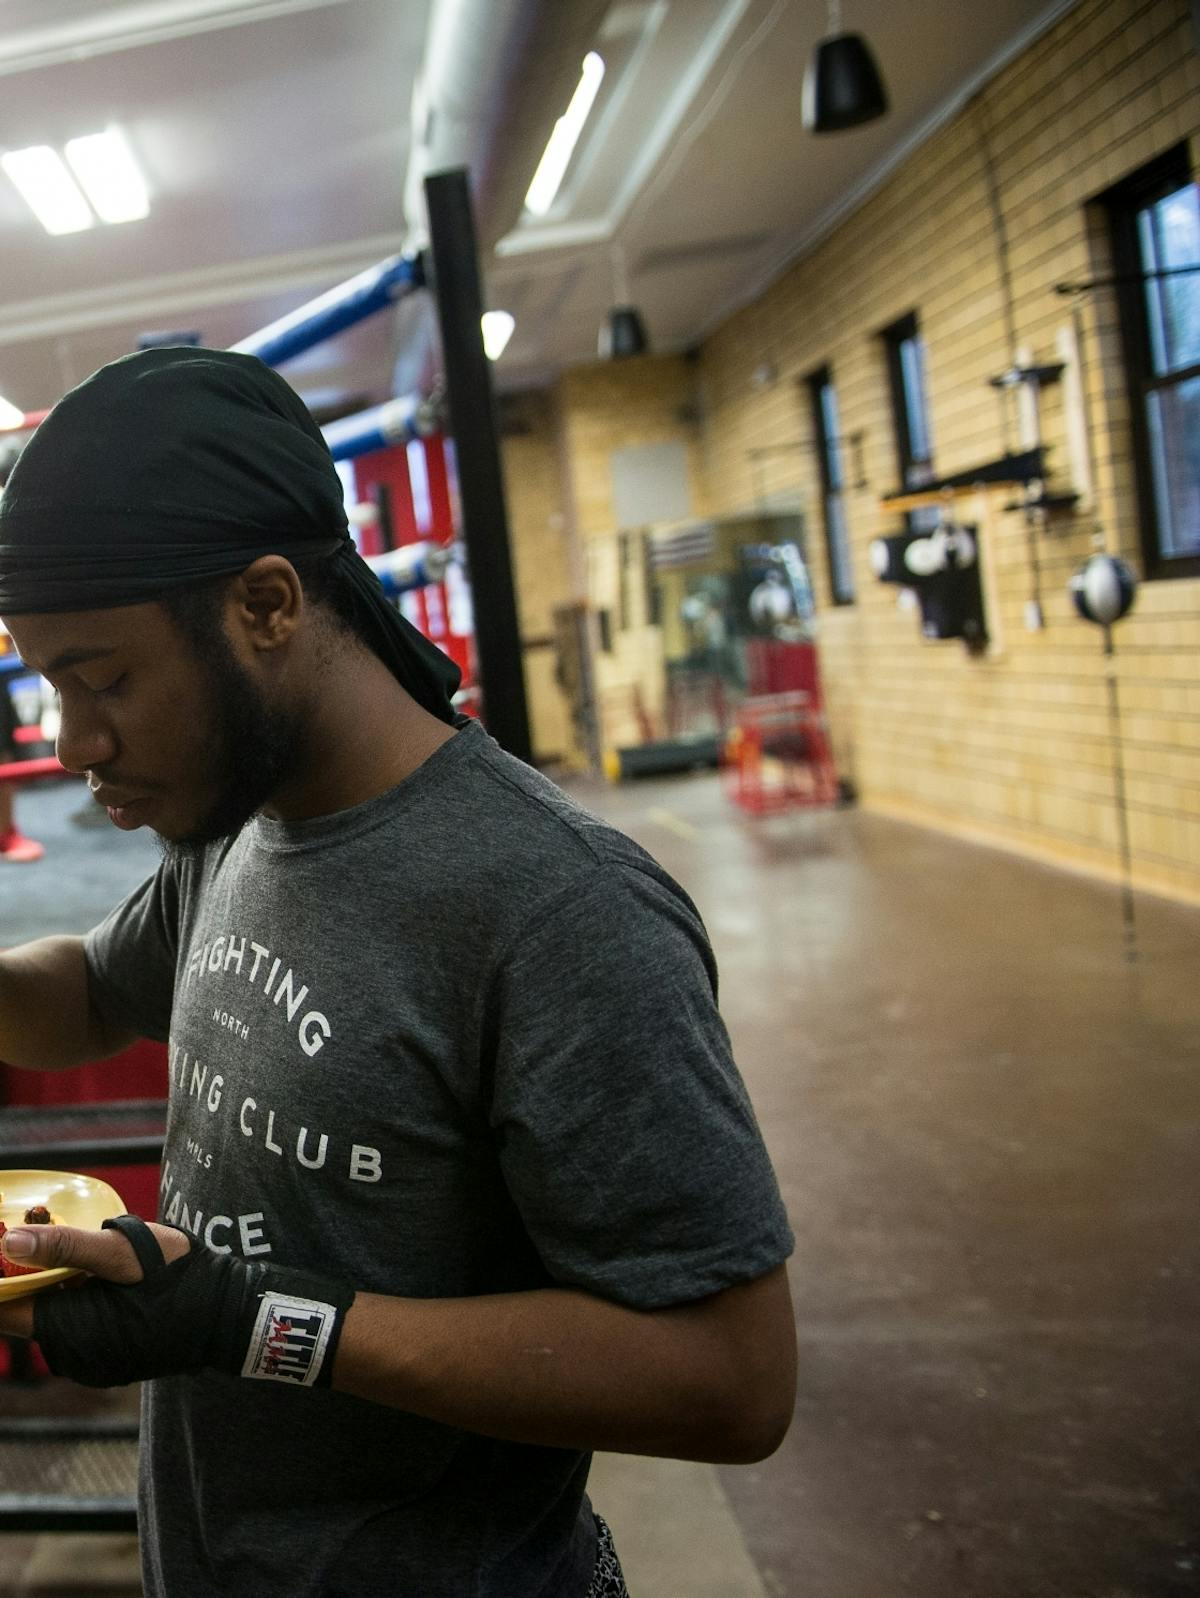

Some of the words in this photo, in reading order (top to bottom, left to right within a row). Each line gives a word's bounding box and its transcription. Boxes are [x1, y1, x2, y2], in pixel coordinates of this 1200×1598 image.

[186, 935, 332, 1057] FIGHTING
[212, 1008, 250, 1040] NORTH
[240, 1097, 383, 1183] CLUB
[160, 1145, 272, 1256] HANCE
